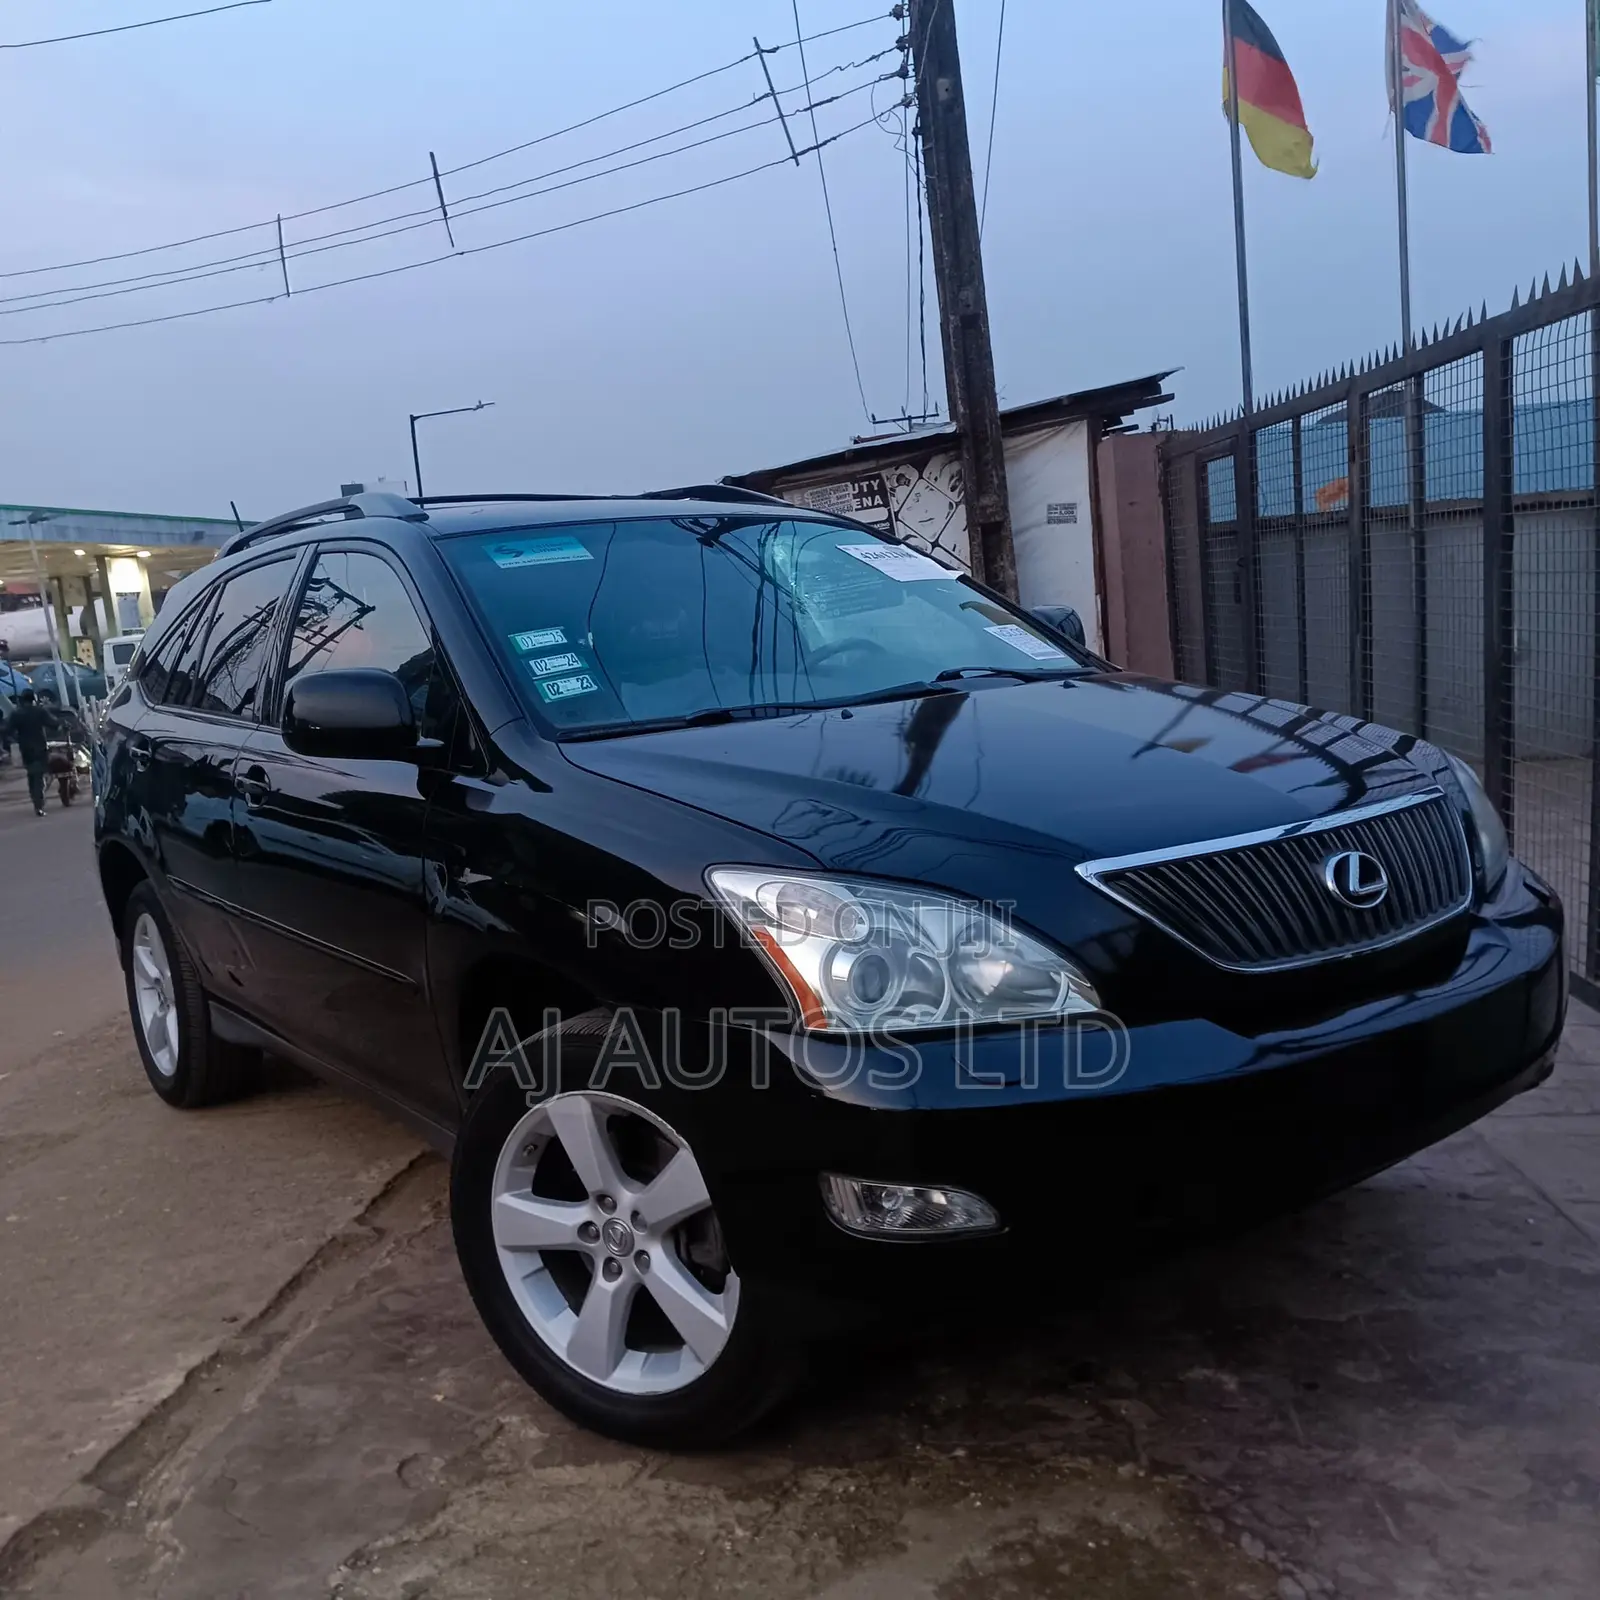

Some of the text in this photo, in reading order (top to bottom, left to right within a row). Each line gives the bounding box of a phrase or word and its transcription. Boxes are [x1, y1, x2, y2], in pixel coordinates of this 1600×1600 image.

[520, 635, 536, 648] 02
[533, 654, 579, 673] 02 24
[546, 676, 593, 697] 02 23
